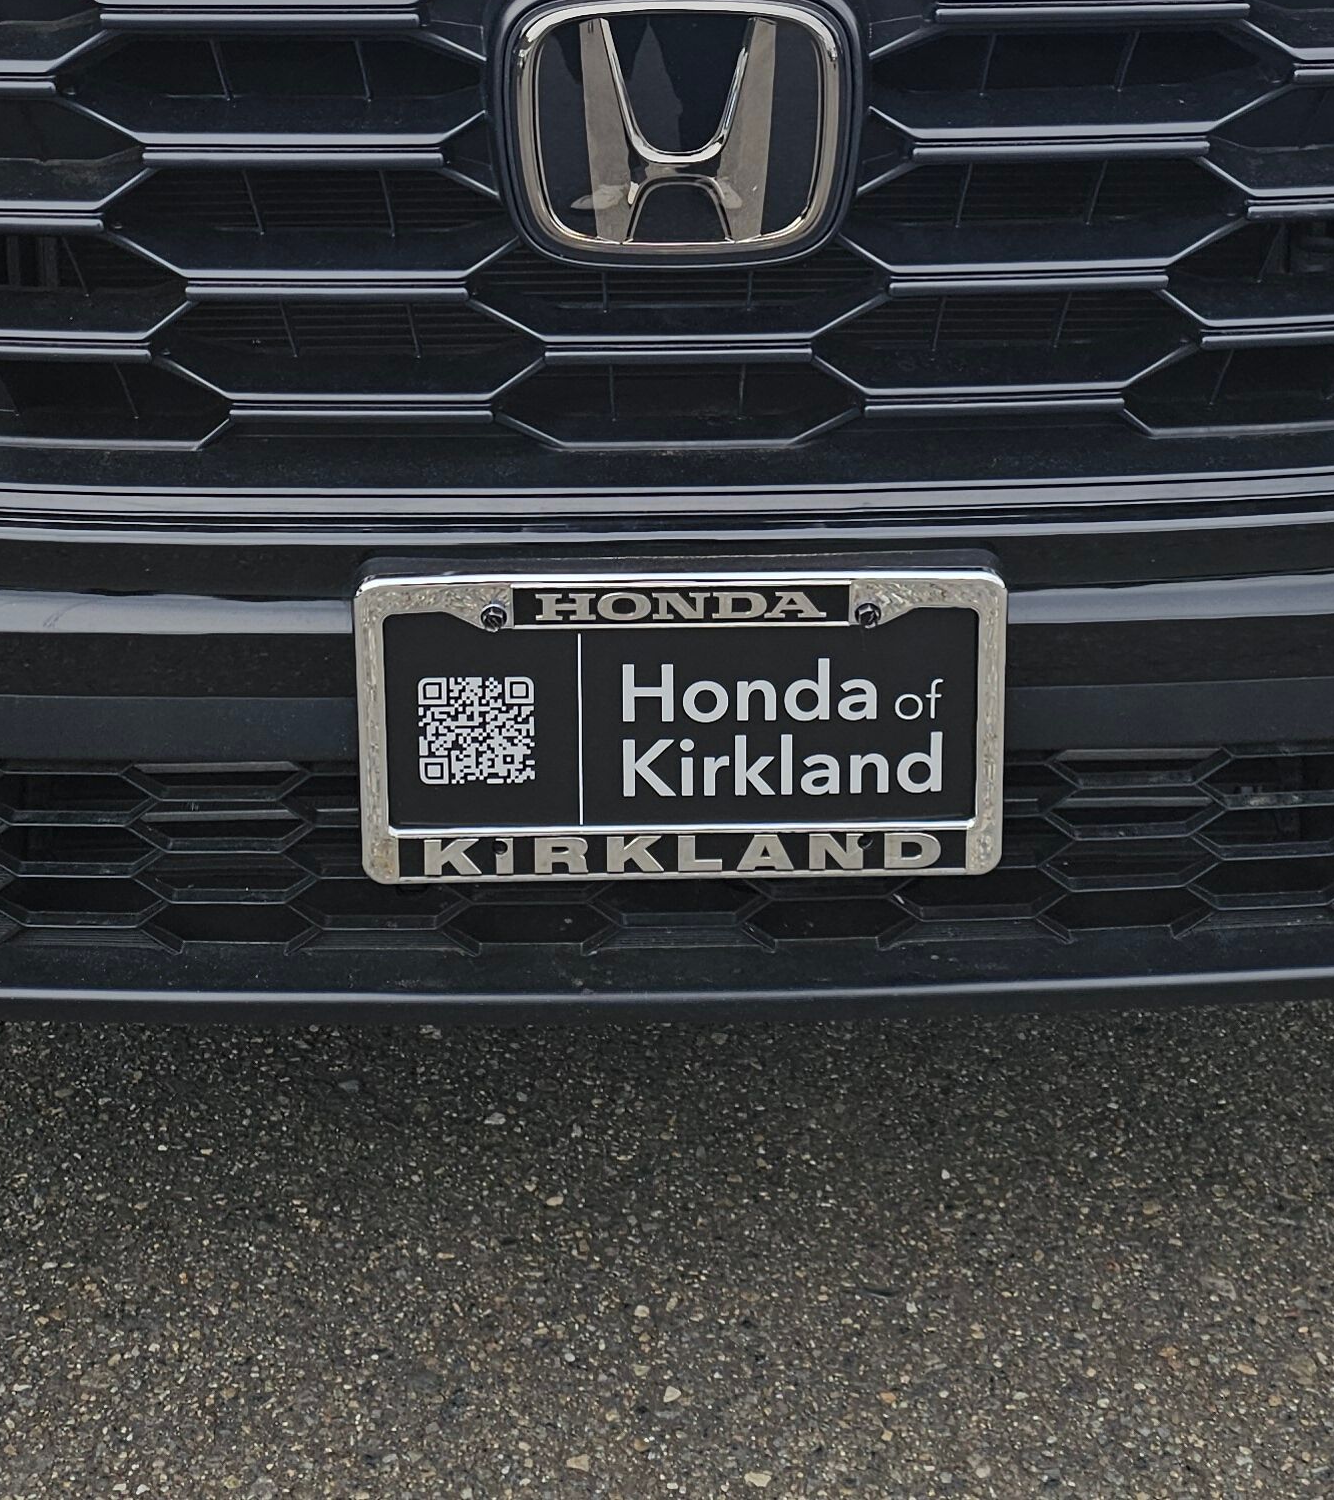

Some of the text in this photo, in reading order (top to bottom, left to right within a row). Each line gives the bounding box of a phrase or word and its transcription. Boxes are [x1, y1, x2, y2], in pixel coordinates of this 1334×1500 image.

[535, 591, 827, 621] HONDA
[621, 657, 944, 723] Honda of
[621, 731, 943, 797] Kirkland
[424, 832, 942, 876] KIRKLAND
